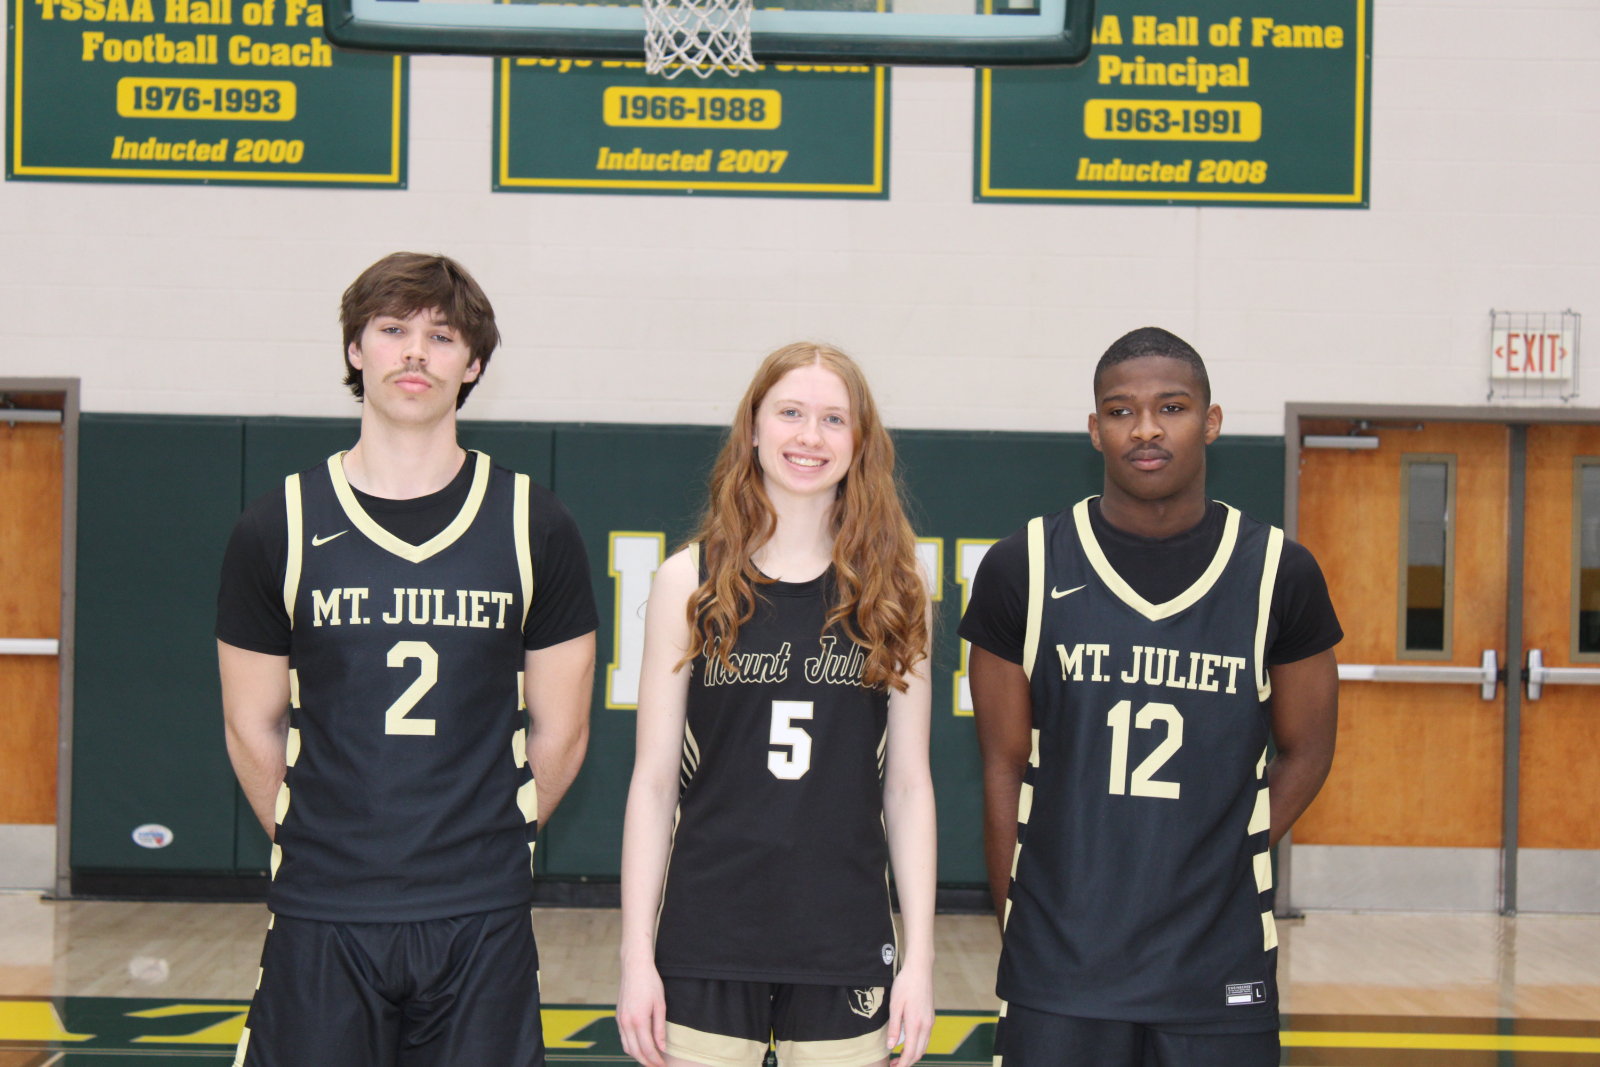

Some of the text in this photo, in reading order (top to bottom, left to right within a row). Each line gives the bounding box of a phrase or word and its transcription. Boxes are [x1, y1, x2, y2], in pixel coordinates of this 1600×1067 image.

[35, 0, 324, 27] TSSAA Hall of Fa
[82, 31, 333, 67] Football Coach
[1132, 15, 1199, 46] Hall
[1208, 17, 1242, 47] of
[1251, 17, 1344, 49] Fame
[1098, 55, 1250, 93] Principal
[133, 86, 281, 113] 1976-1993
[620, 95, 766, 122] 1966-1988
[1104, 108, 1241, 134] 1963-1991
[111, 136, 305, 163] Inducted 2000
[596, 147, 789, 173] Inducted 2007
[1076, 157, 1268, 184] Inducted 2008
[1506, 333, 1560, 372] EXIT
[311, 587, 513, 629] MT. JULIET
[1056, 643, 1246, 694] MT. JULIET
[384, 640, 439, 736] 2
[767, 700, 814, 780] 5
[1106, 699, 1184, 800] 12
[1255, 988, 1262, 998] L
